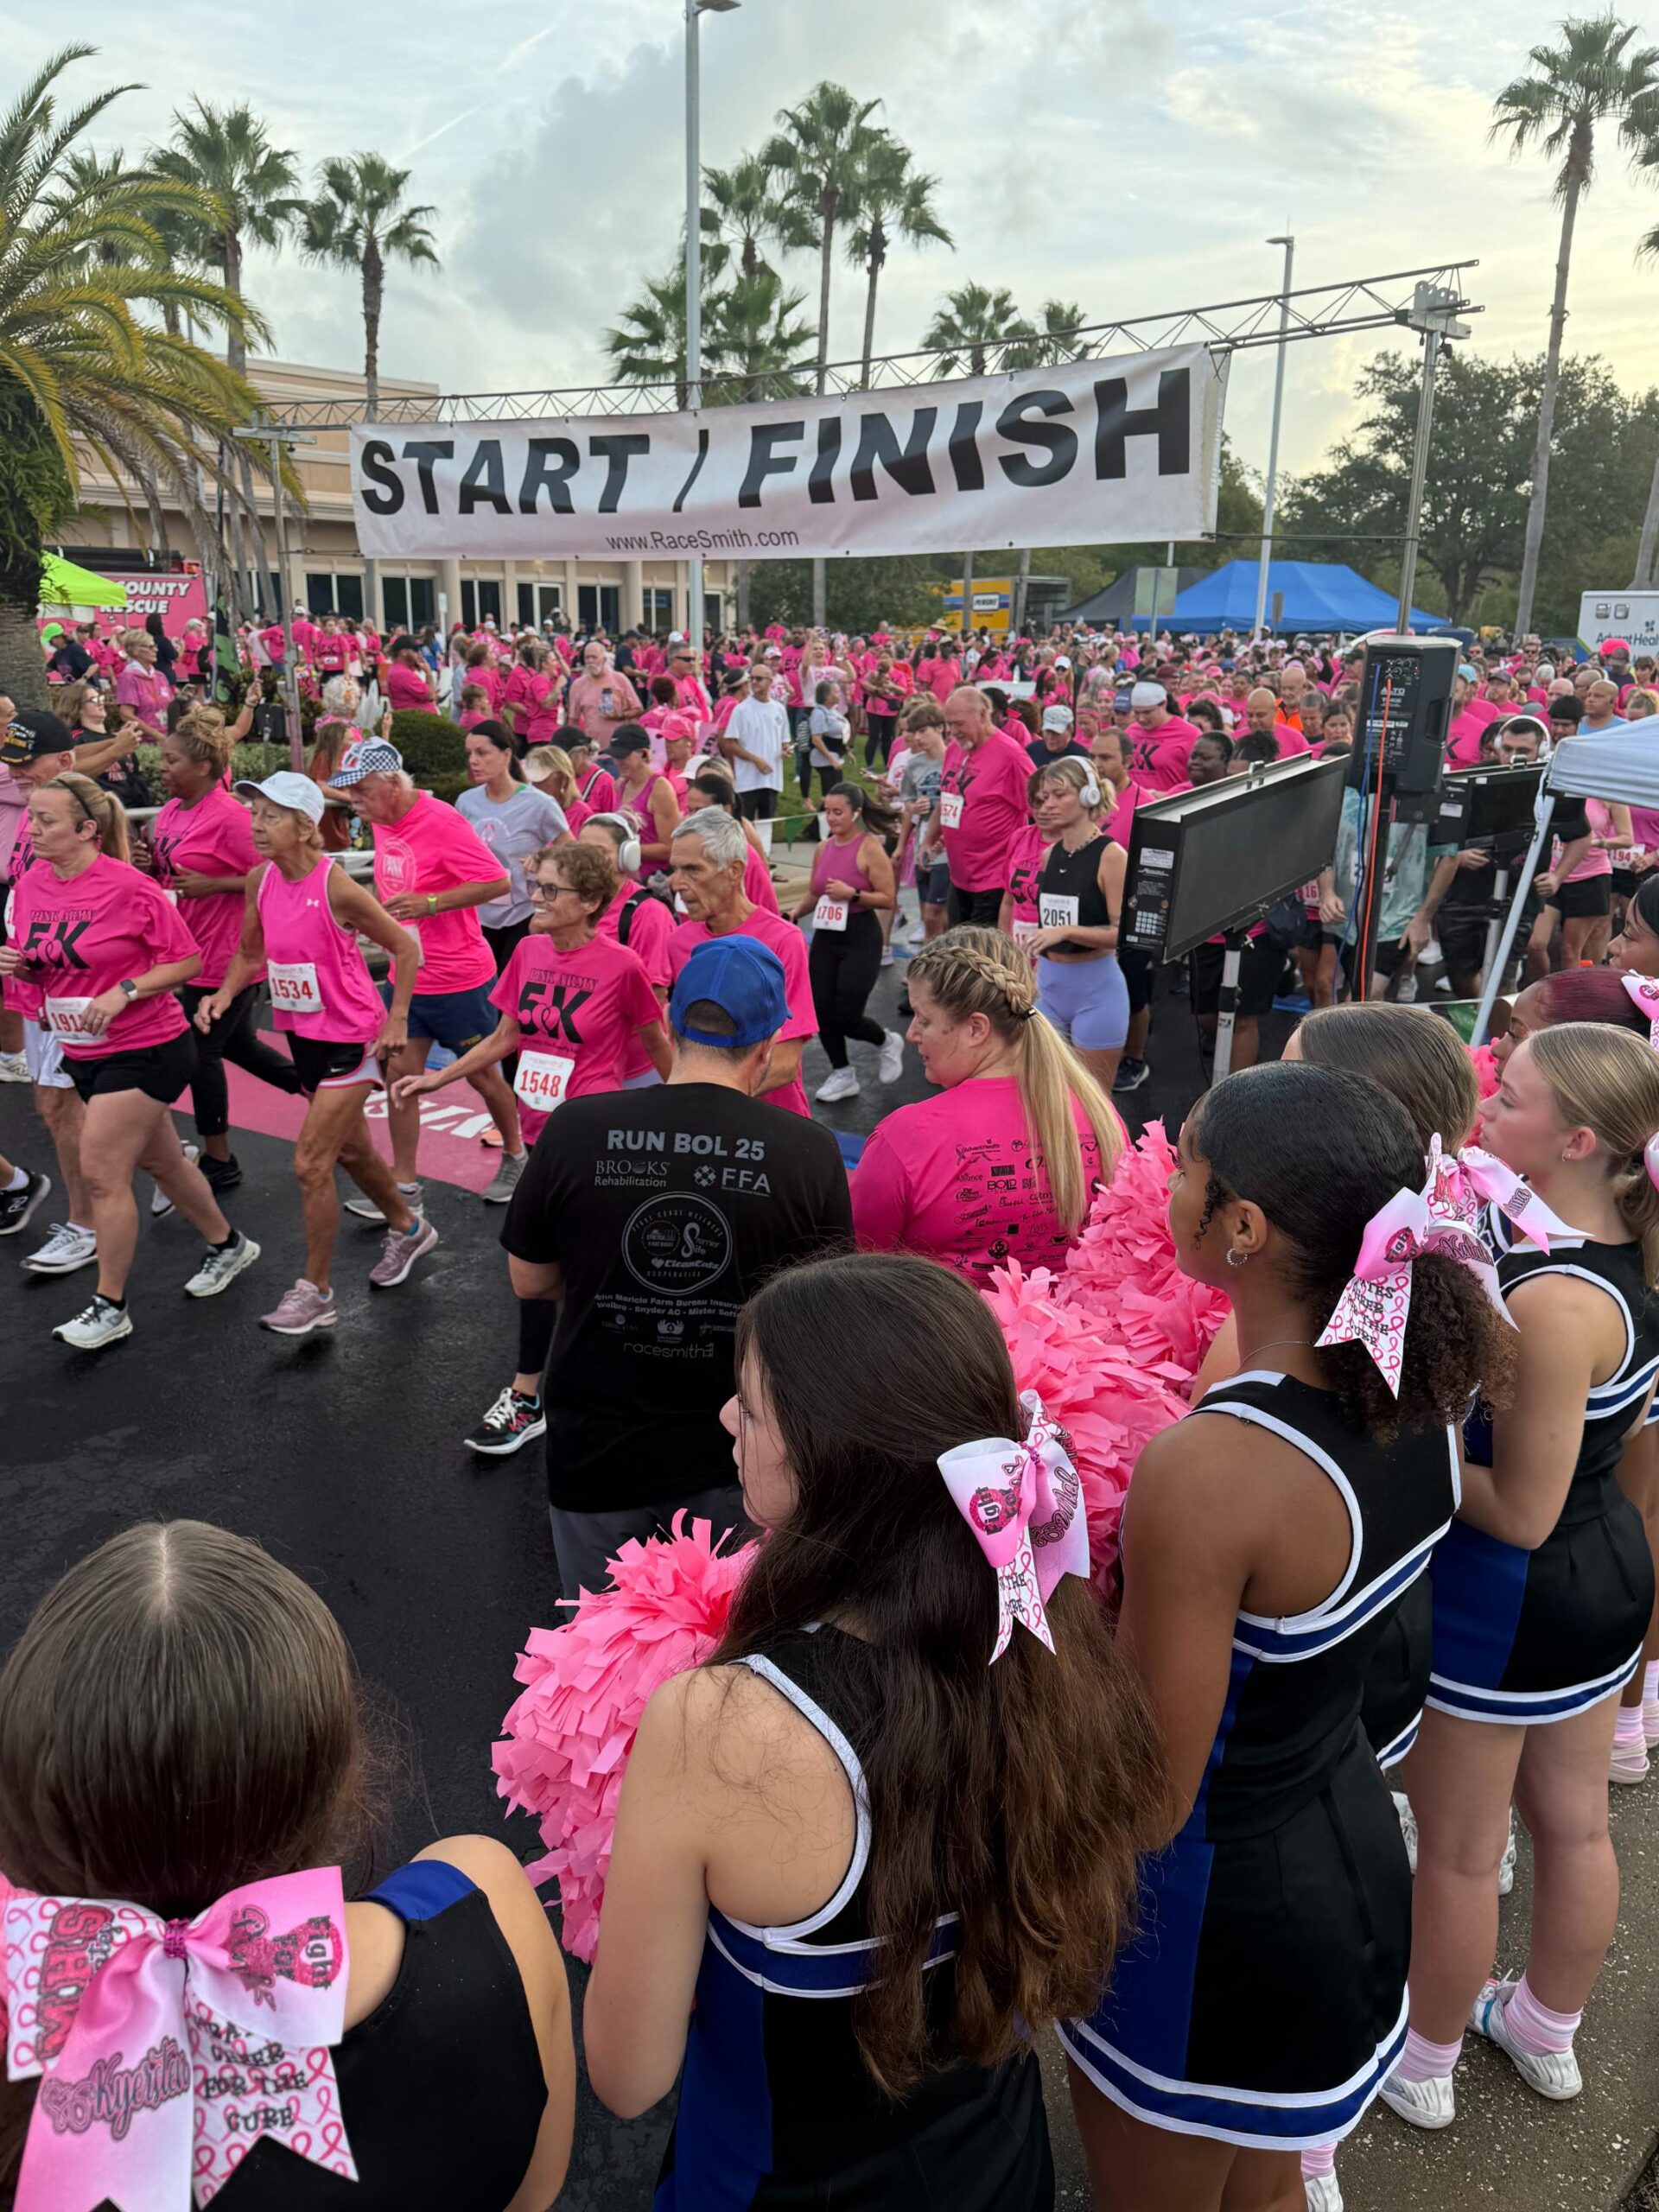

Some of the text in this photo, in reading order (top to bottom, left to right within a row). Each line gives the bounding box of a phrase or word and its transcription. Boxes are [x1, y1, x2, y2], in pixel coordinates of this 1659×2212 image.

[361, 367, 1191, 515] START / FINISH
[606, 529, 799, 550] www.RaceSmith.com
[30, 910, 60, 922] PINK
[817, 906, 842, 920] 1706
[1044, 908, 1071, 925] 2051
[22, 921, 92, 969] 5K
[272, 977, 313, 1000] 1534
[529, 968, 599, 992] PINK ARMY
[51, 1013, 84, 1033] 191
[518, 981, 594, 1045] 5K
[519, 1069, 562, 1098] 1548
[607, 1129, 766, 1161] RUN BOL 25
[594, 1176, 666, 1188] Rehabilitation
[721, 1167, 772, 1193] FFA
[688, 1307, 716, 1316] Mister
[623, 1343, 705, 1358] racesmith
[975, 1487, 1002, 1536] Fight
[305, 1915, 334, 1991] Fight
[204, 2070, 309, 2099] FOR THE
[226, 2107, 296, 2132] CURE
